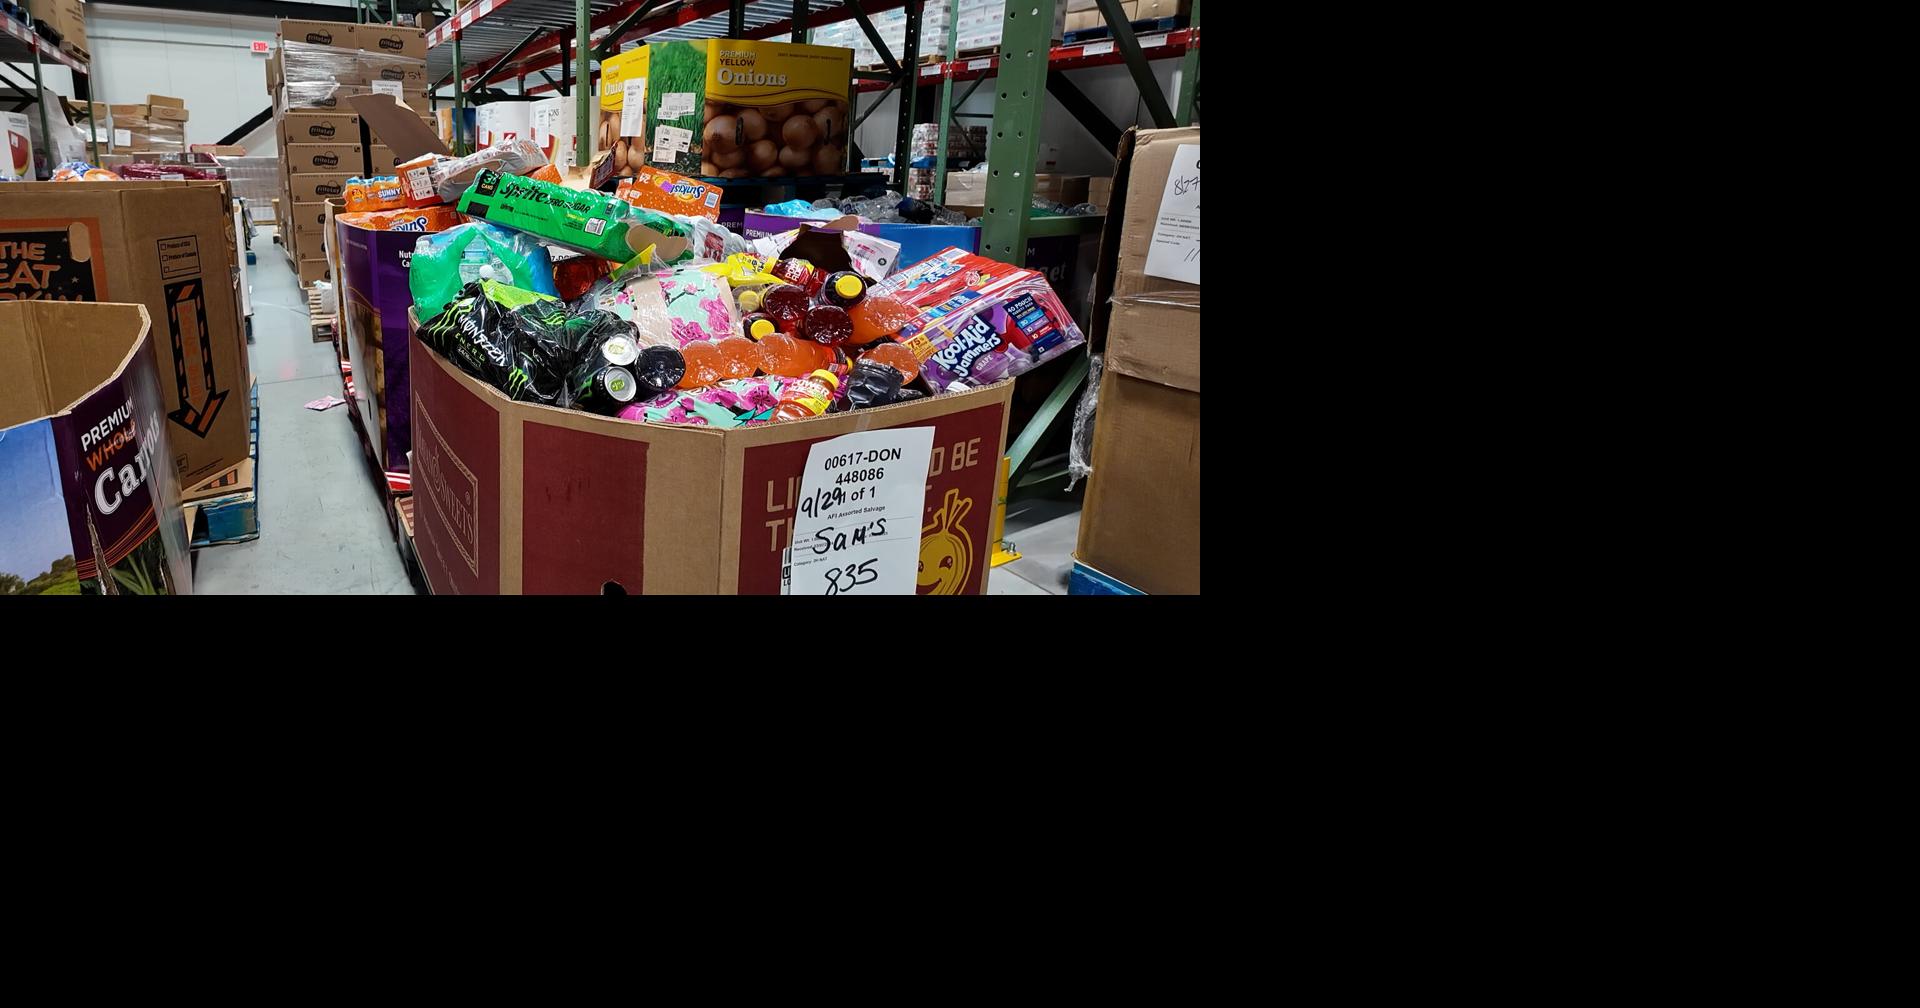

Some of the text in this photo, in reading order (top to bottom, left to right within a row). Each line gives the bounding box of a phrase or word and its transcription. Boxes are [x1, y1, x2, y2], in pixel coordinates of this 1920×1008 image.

[253, 42, 266, 51] EXIT
[719, 50, 756, 58] PREMIUM
[720, 58, 755, 67] YELLOW
[717, 68, 788, 86] Onions
[377, 186, 400, 199] SUNNY
[500, 182, 550, 203] Sprite
[546, 198, 564, 209] ZERO
[669, 184, 705, 198] Sunkist
[0, 241, 46, 260] THE
[399, 250, 412, 258] Nut
[953, 333, 1002, 377] Jammers
[976, 354, 994, 372] GRAPE
[80, 396, 134, 453] PREMIUM
[824, 447, 902, 471] 00617-DON
[951, 437, 981, 471] BE
[835, 467, 884, 486] 448086
[851, 488, 865, 502] of
[869, 486, 876, 499] 1
[838, 508, 863, 519] Assorted
[863, 505, 886, 515] Salvage
[824, 558, 878, 595] 835
